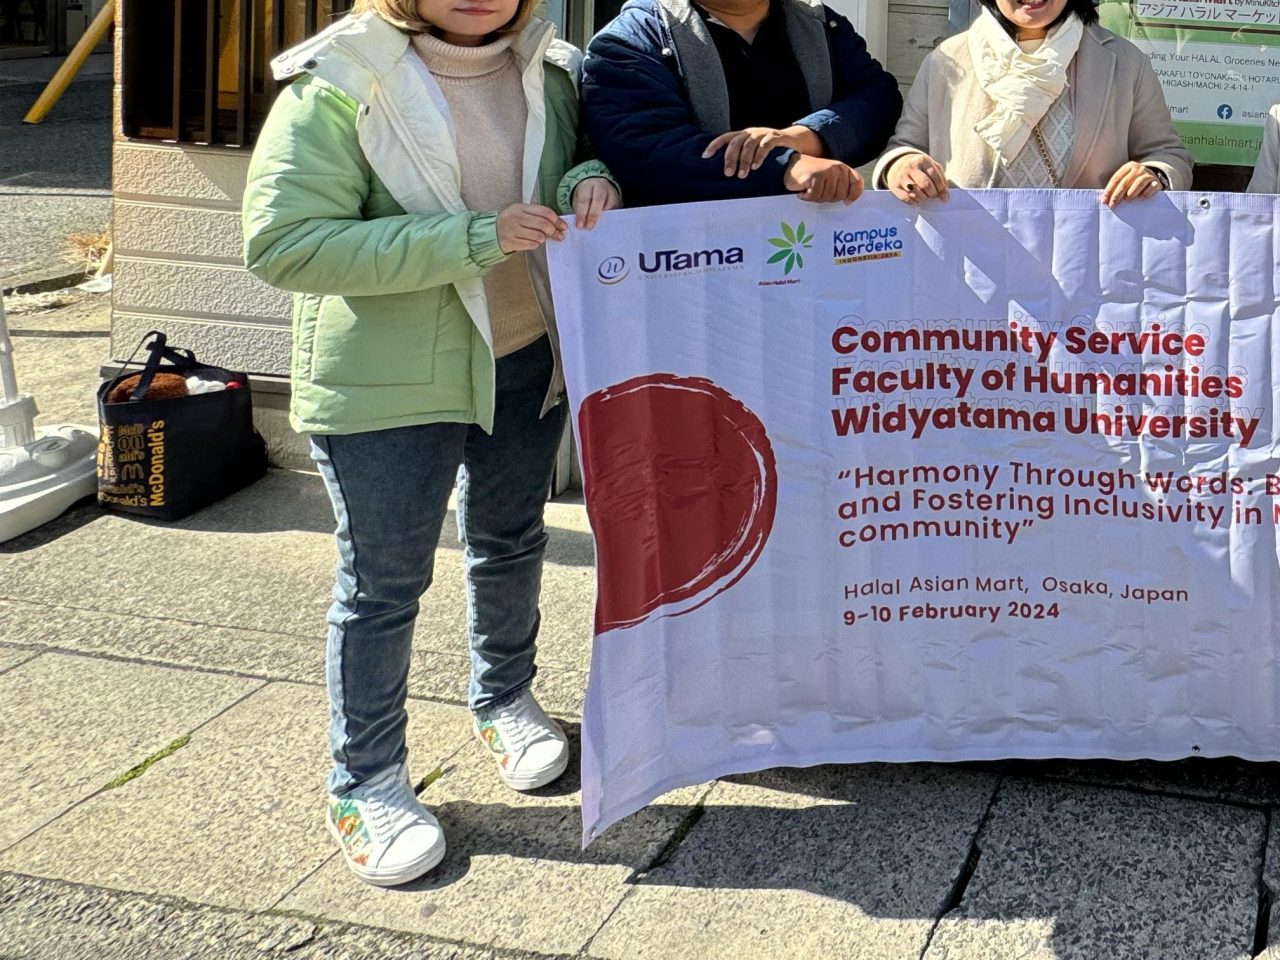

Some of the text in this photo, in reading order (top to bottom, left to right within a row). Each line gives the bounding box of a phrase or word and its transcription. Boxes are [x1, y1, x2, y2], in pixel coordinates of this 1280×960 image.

[1138, 3, 1179, 17] アジア
[1180, 6, 1221, 20] ハラル
[1169, 53, 1189, 61] Your
[1191, 54, 1221, 64] HALAL
[1224, 55, 1266, 67] Groceries
[1162, 79, 1222, 90] HIGASHIMACHI
[833, 226, 898, 245] Kampus
[833, 239, 904, 258] Merdeka
[639, 247, 744, 273] UTama
[831, 321, 1206, 363] Community Service
[831, 363, 1243, 399] Faculty of Humanities
[831, 399, 1260, 448] Widyatama University
[147, 419, 165, 507] McDonald's
[1009, 461, 1136, 496] Through
[1144, 470, 1255, 496] Words:
[837, 487, 901, 520] and
[913, 487, 1055, 520] Fostering
[1064, 494, 1225, 530] Inclusivity
[1234, 499, 1263, 525] in
[843, 575, 1189, 604] Halal Asian Mart, Osaka, Japan
[842, 602, 1060, 627] 9-10 February 2024
